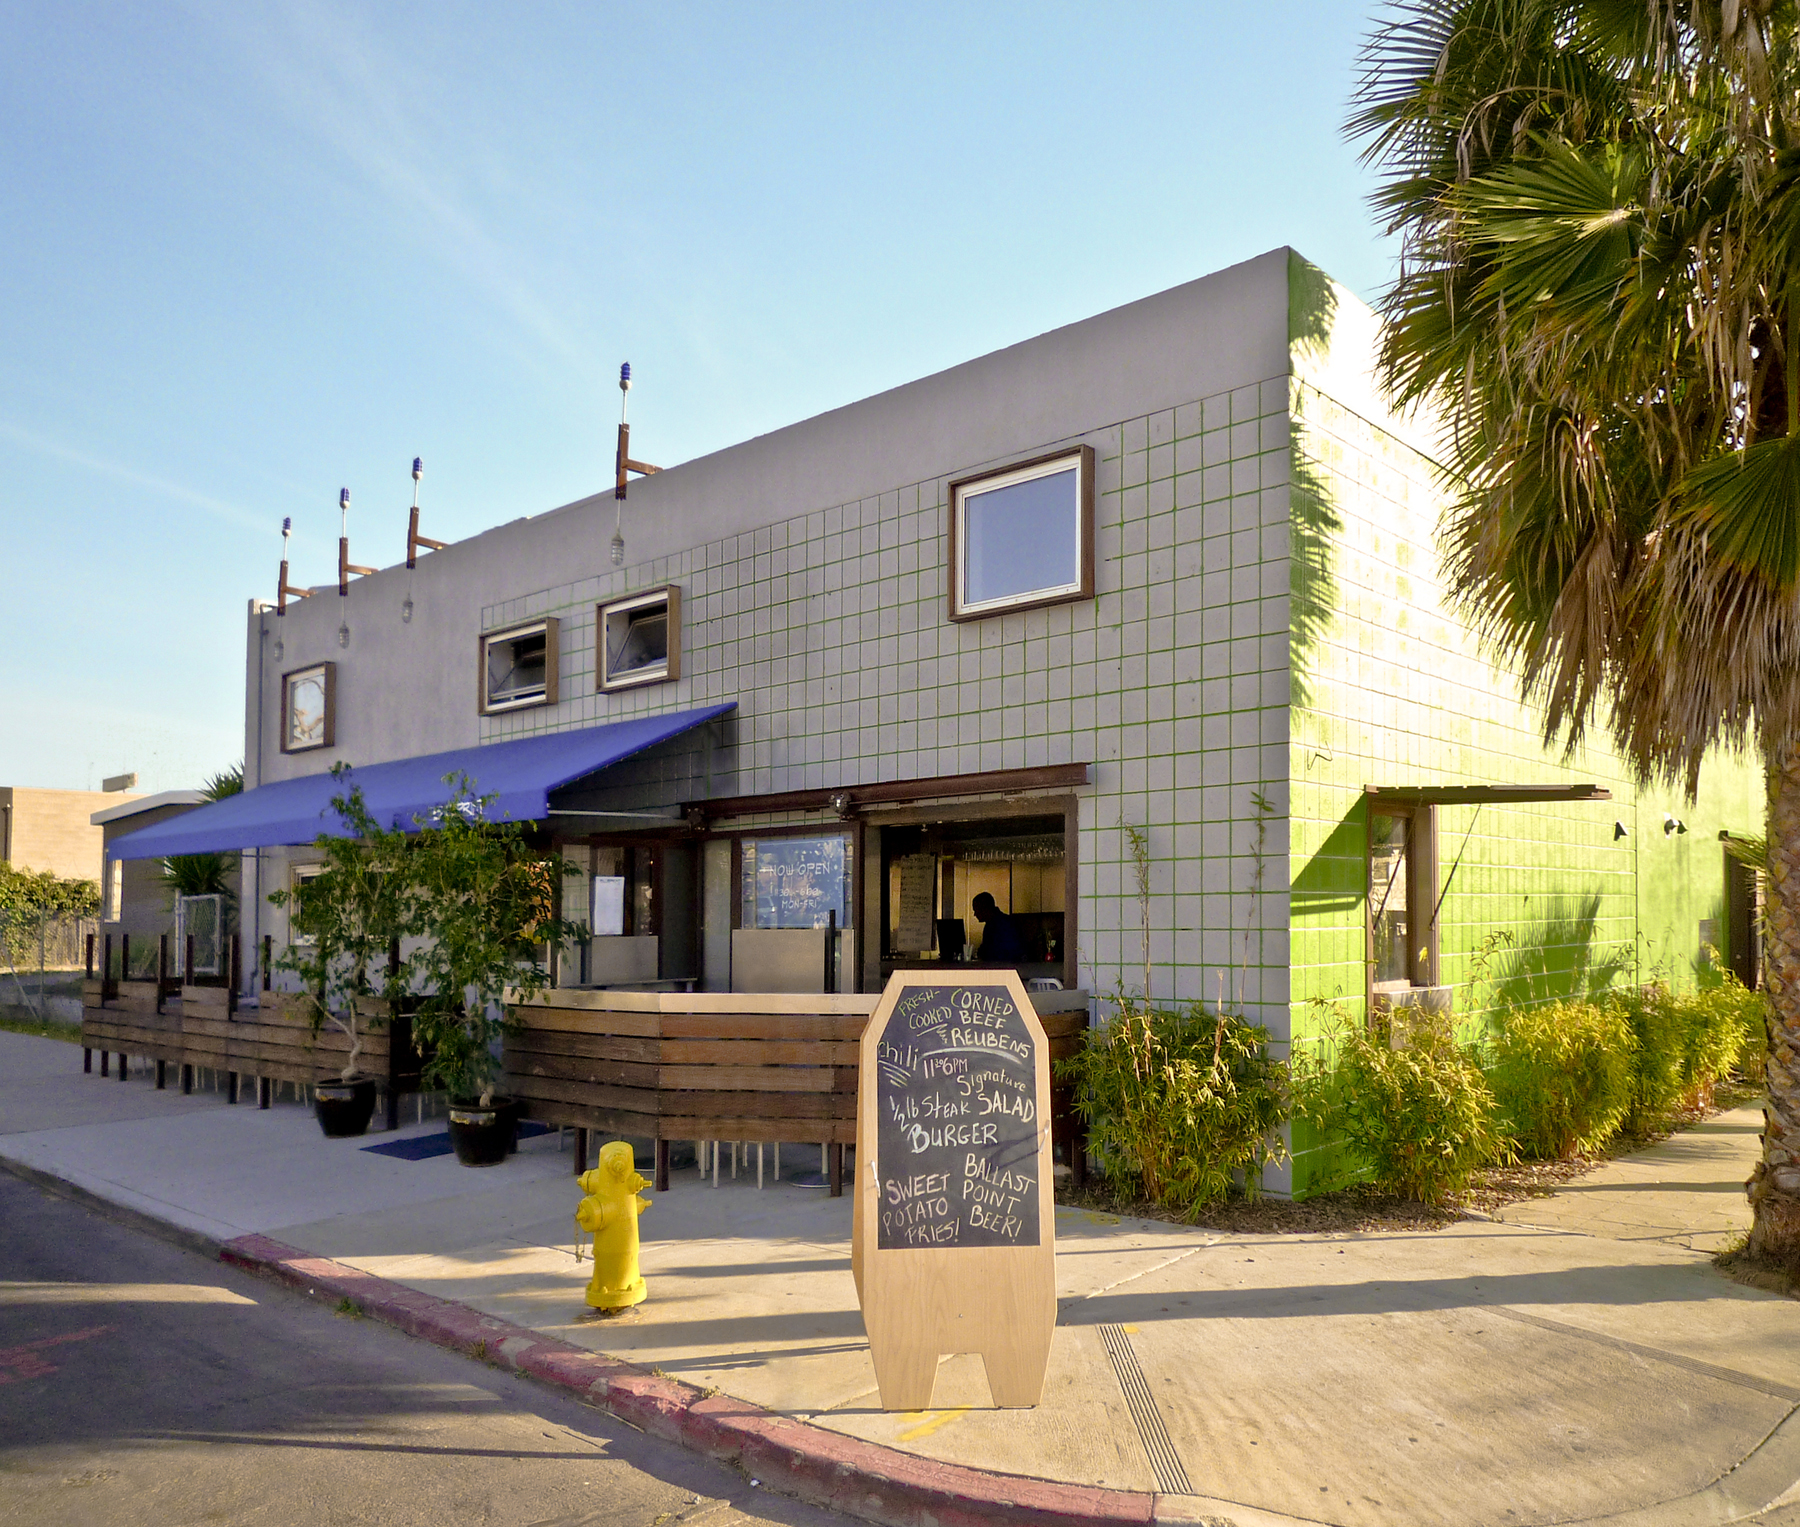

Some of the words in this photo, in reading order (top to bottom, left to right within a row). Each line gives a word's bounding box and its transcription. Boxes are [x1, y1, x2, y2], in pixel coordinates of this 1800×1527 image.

[769, 863, 794, 877] NOW
[797, 861, 831, 876] OPEN
[909, 1006, 952, 1030] COOKED
[950, 988, 1013, 1016] CORNED
[959, 1010, 1007, 1030] BEEF
[878, 1041, 919, 1071] Chili
[950, 1027, 1031, 1059] REUBENS
[957, 1069, 1026, 1096] Signature
[977, 1090, 1035, 1123] SALAD
[907, 1122, 999, 1154] BURGER
[885, 1172, 951, 1205] SWEET
[964, 1152, 1037, 1195] BALLAST
[962, 1178, 1021, 1214] POINT
[883, 1197, 948, 1237] POTATO
[905, 1216, 961, 1245] FRIES!
[969, 1204, 1023, 1243] BEER!
